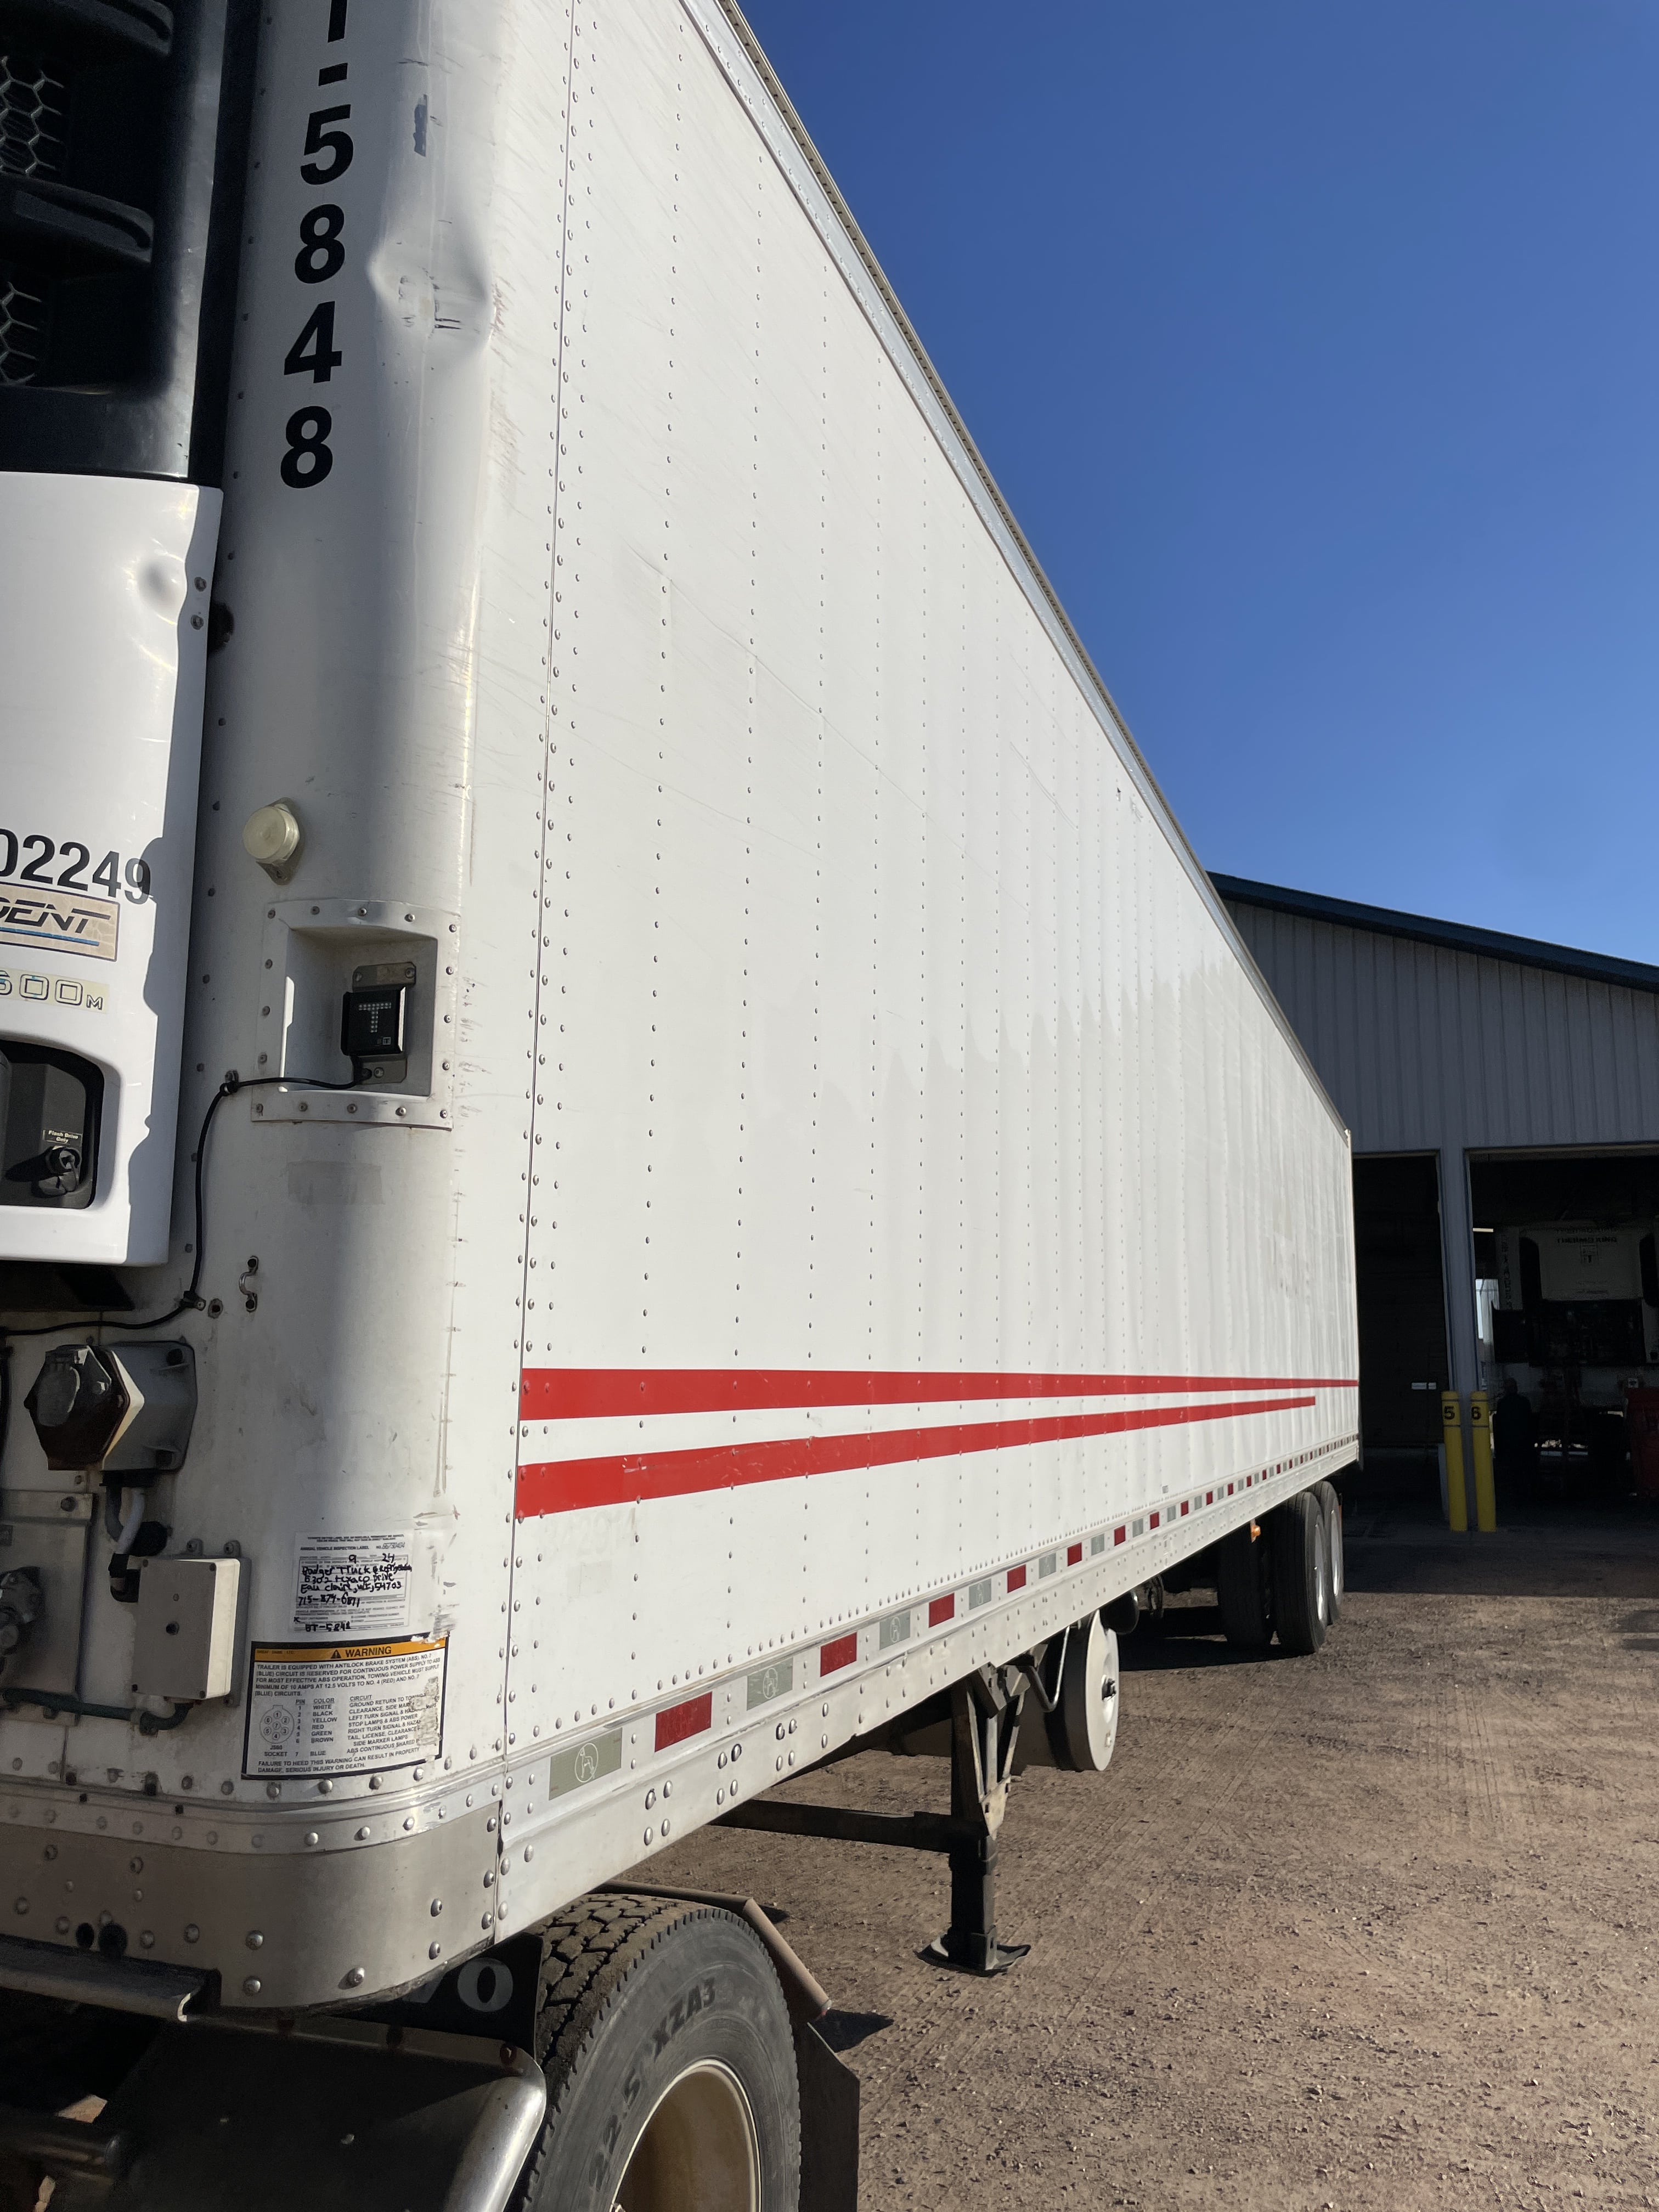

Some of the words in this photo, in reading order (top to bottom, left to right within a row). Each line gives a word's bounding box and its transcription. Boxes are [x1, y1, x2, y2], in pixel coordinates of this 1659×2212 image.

[0, 828, 151, 905] 02249
[0, 896, 111, 934] ENT
[1443, 1406, 1455, 1420] 5
[1471, 1406, 1481, 1420] 6
[382, 1553, 395, 1563] 24
[345, 1646, 392, 1657] WARNING
[353, 1665, 389, 1674] CONTINUOUS
[388, 1726, 416, 1735] CLEARANCE
[360, 1743, 395, 1752] CONTINUOUS
[395, 1747, 420, 1756] PROPERTY
